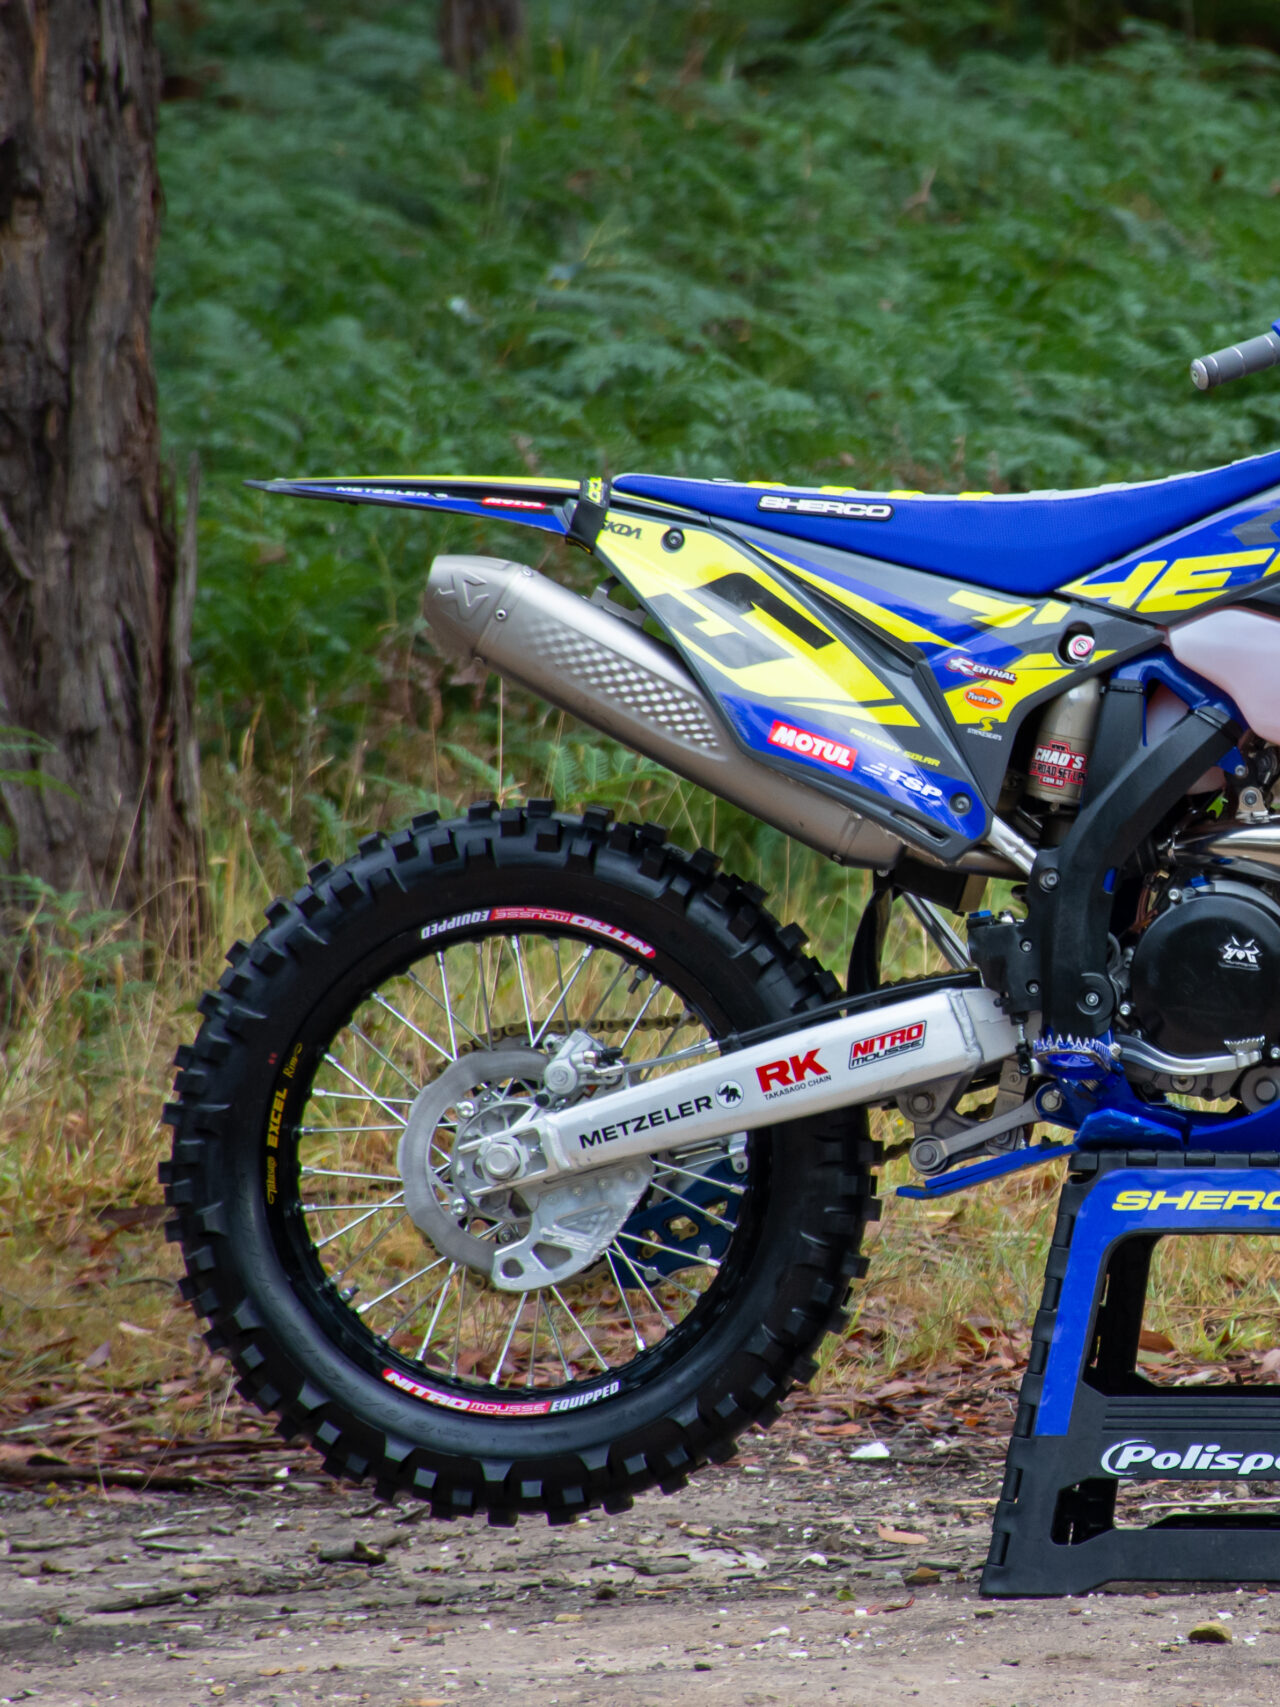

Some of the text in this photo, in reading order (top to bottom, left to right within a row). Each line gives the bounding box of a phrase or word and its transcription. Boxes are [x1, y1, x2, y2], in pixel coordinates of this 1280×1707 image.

[759, 495, 892, 518] SHERCO
[946, 657, 1017, 682] RENTHAL
[772, 725, 851, 768] MOTUL
[902, 750, 941, 768] SOLAR
[1034, 747, 1085, 770] CHAD'S
[886, 766, 943, 798] TSP
[420, 909, 490, 940] EQUIPPED
[495, 910, 570, 924] MOUSSE
[569, 914, 653, 956] NITRO
[851, 1039, 923, 1067] MOUSSE
[852, 1023, 924, 1058] NITRO
[755, 1047, 829, 1093] RK
[764, 1074, 832, 1101] TAKASAGO CHAIN
[266, 1087, 288, 1149] EXCEL
[579, 1095, 713, 1149] METZELER
[384, 1371, 620, 1413] NITRO MOUSSE EQUIPPED
